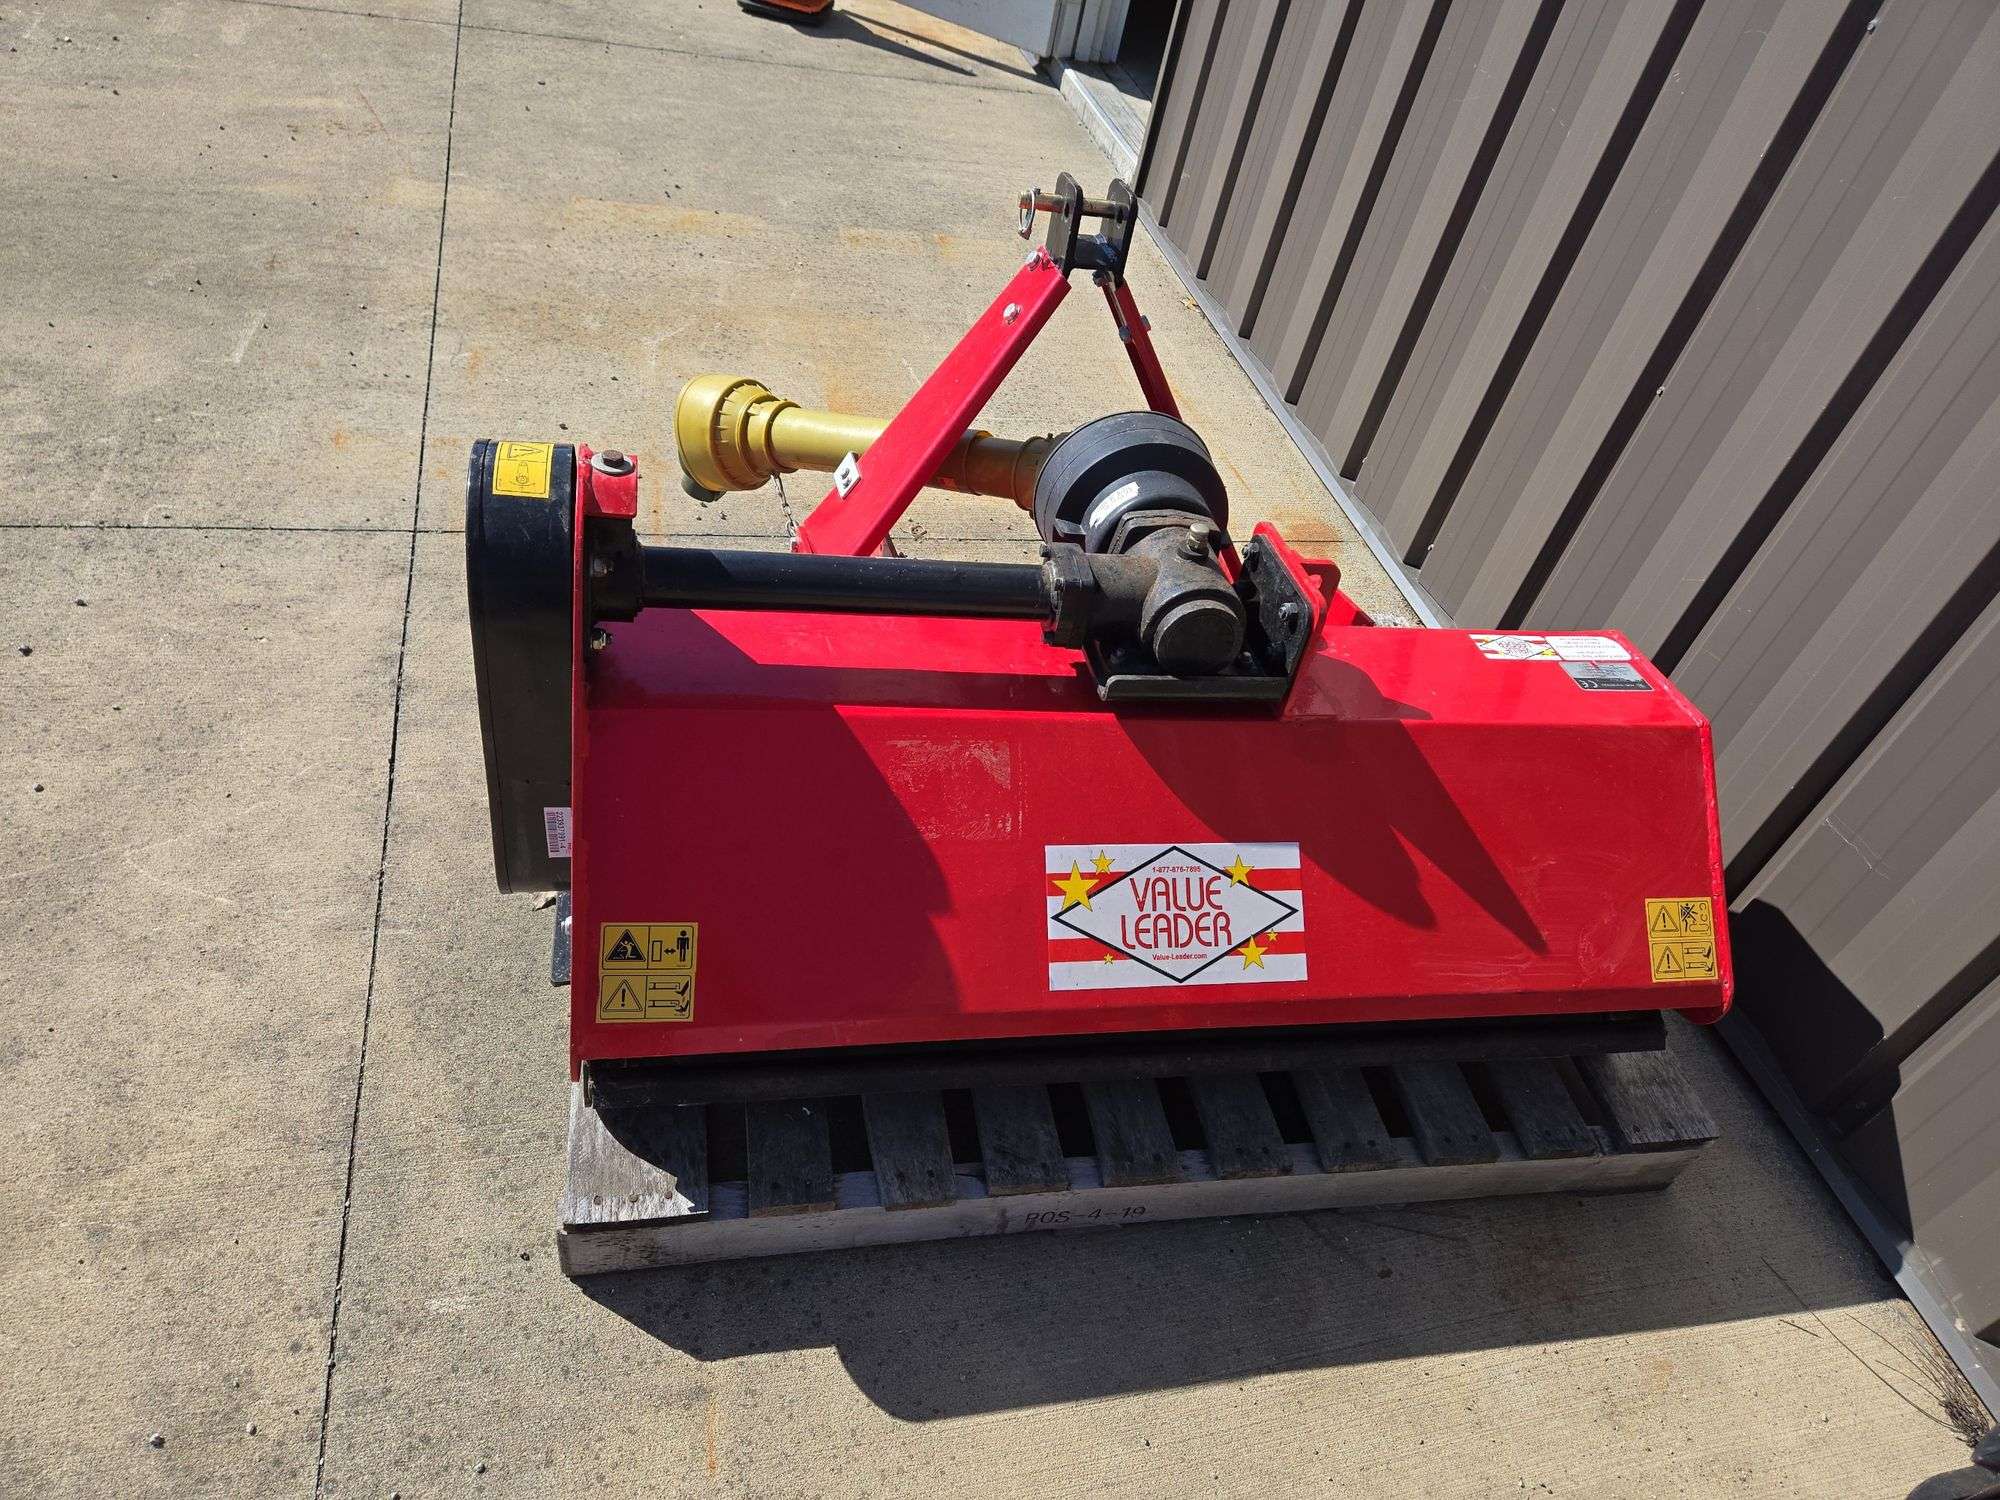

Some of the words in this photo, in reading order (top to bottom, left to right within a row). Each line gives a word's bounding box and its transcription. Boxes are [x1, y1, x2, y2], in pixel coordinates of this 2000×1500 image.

[1129, 876, 1222, 911] VALUE
[1120, 912, 1232, 949] LEADER
[1152, 953, 1208, 961] Value-Leader.com
